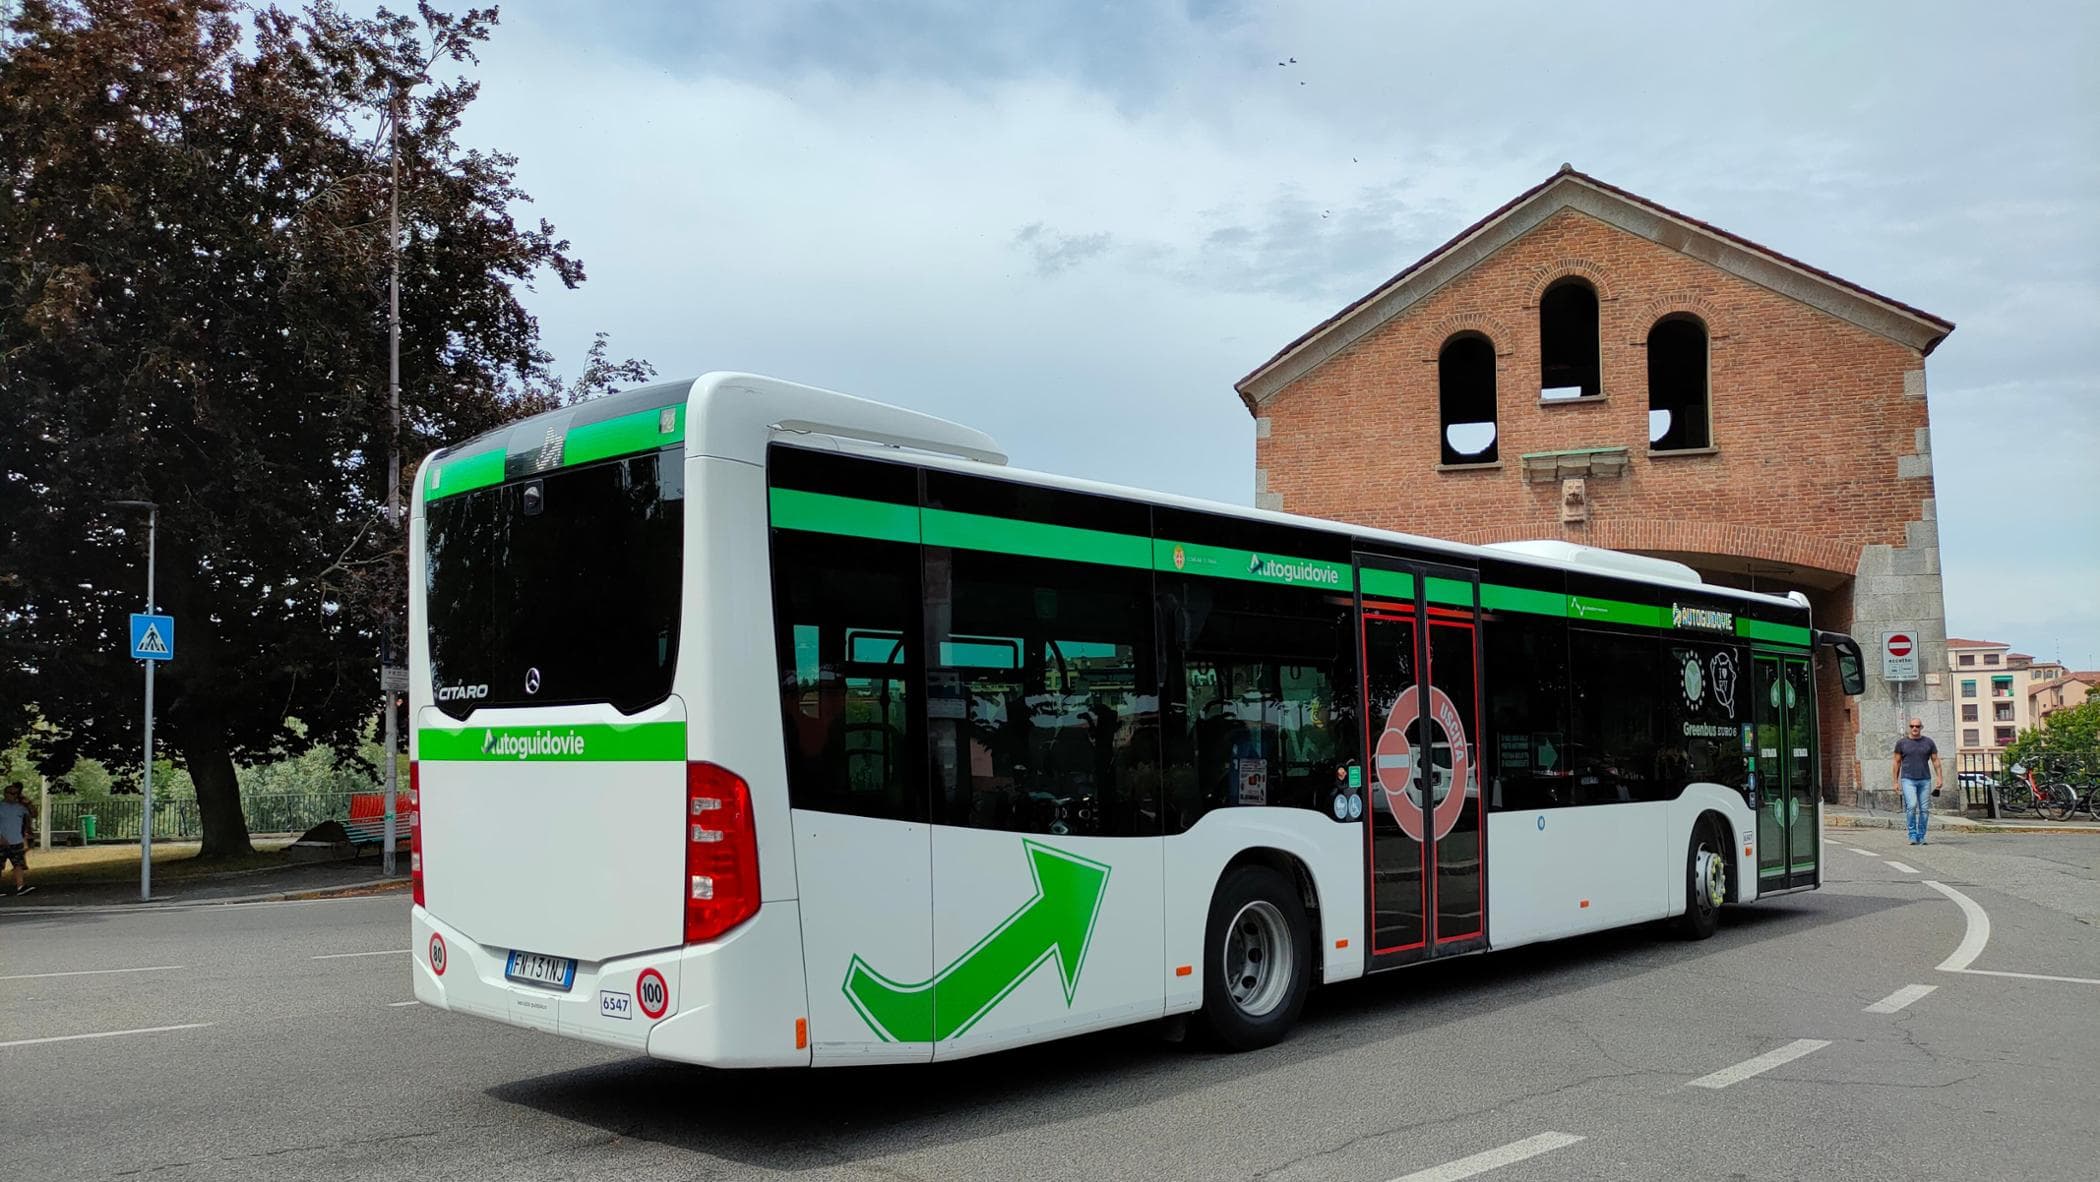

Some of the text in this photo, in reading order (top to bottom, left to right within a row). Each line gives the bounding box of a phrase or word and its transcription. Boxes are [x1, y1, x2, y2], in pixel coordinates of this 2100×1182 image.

[1248, 553, 1338, 584] Autoguidovie
[438, 680, 489, 701] CITARO
[1439, 702, 1465, 763] USCITA
[1683, 721, 1717, 737] Greenbus
[481, 729, 585, 759] Autoguidovie
[433, 944, 442, 960] 80
[642, 982, 663, 1003] 100
[603, 997, 628, 1012] 6547
